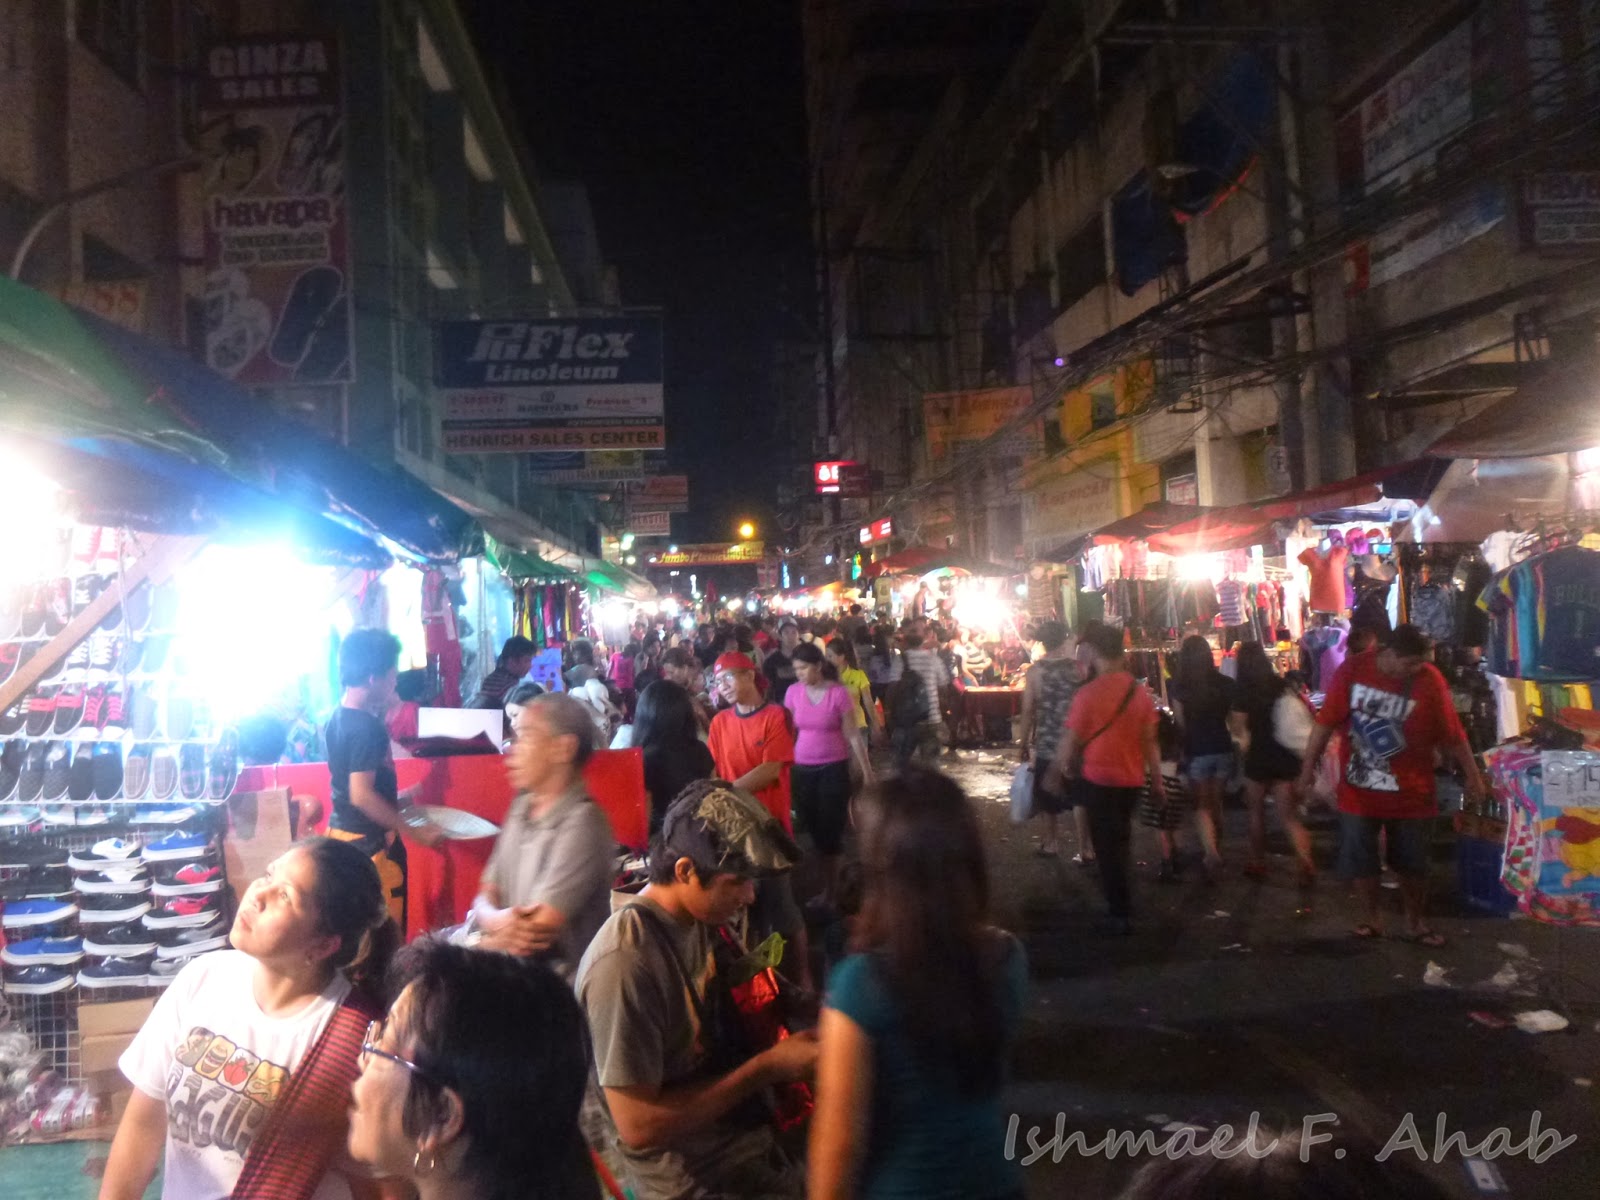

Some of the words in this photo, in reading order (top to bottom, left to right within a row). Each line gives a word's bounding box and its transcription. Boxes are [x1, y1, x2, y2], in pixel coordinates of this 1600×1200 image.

[207, 41, 329, 77] GINZA
[221, 78, 320, 99] SALES
[484, 363, 621, 382] Linoleum
[446, 433, 523, 448] HENRICH
[529, 431, 584, 446] SALES
[590, 430, 659, 445] CENTER
[657, 551, 689, 564] Jumbo
